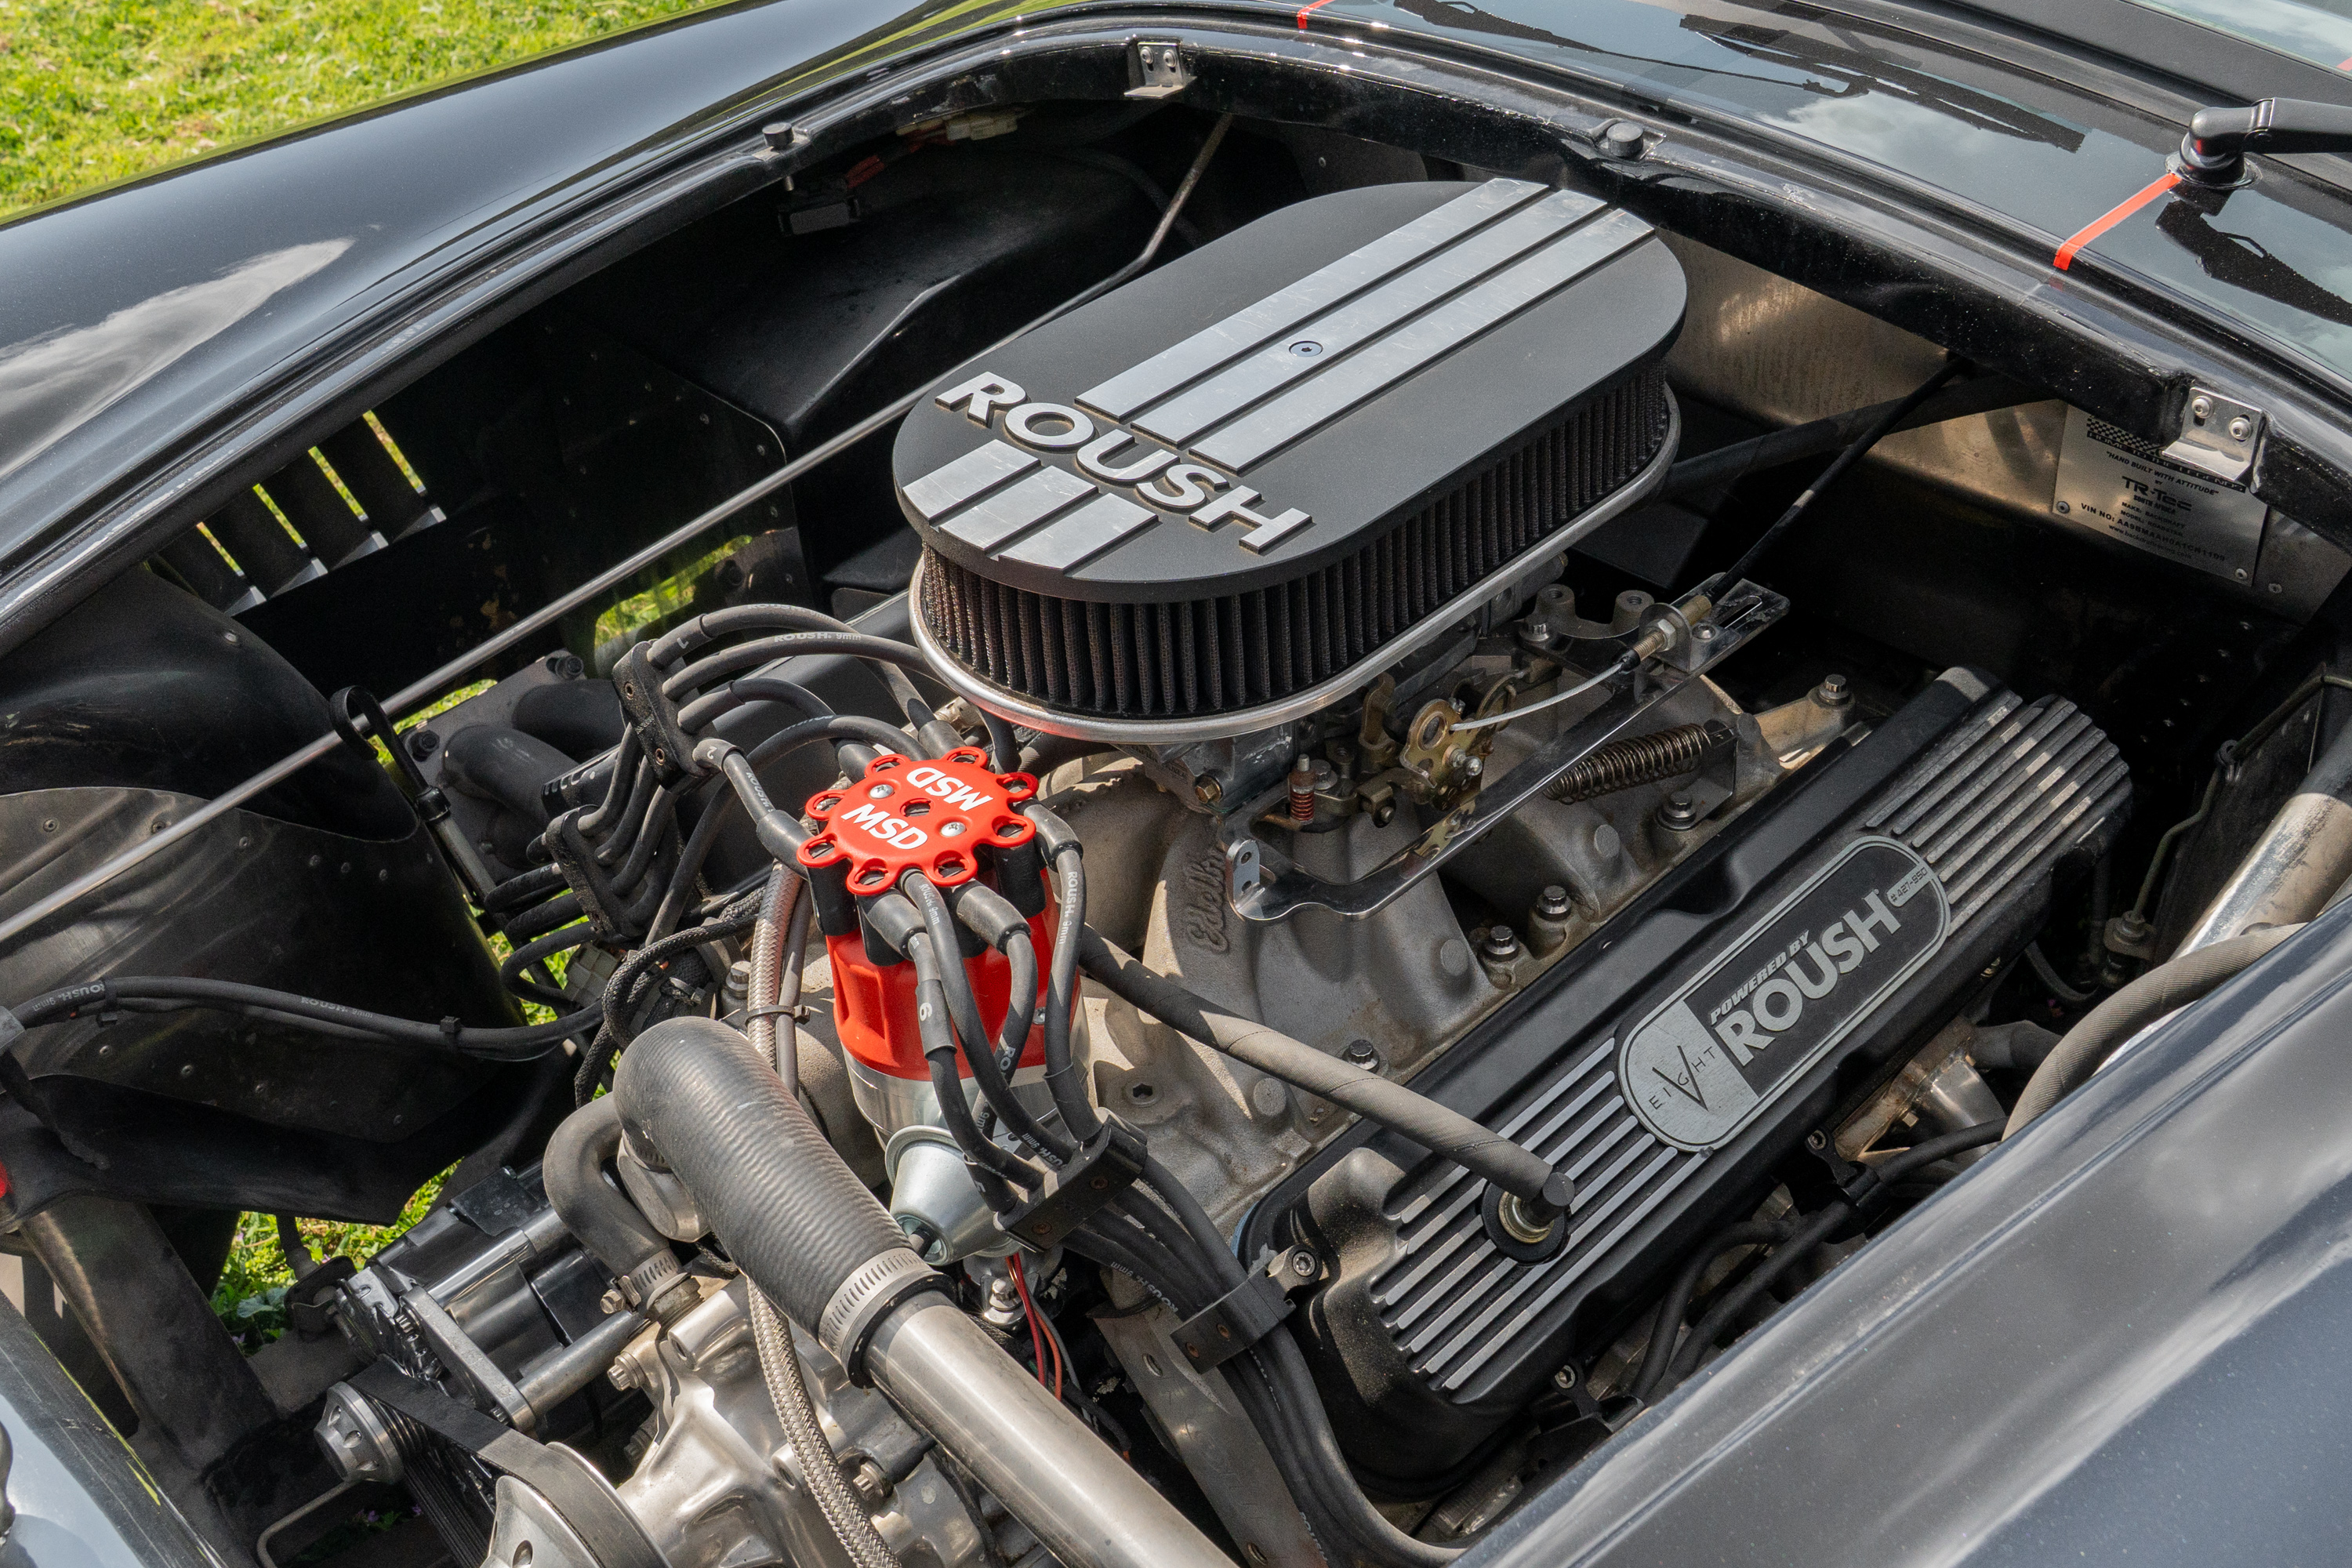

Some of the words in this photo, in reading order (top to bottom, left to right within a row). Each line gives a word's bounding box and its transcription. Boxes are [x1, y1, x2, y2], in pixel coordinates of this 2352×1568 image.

[935, 372, 1312, 554] ROUSH
[2106, 450, 2130, 465] "HAND
[2130, 460, 2153, 474] BUILT
[2154, 469, 2174, 482] WITH
[2175, 475, 2219, 499] ATTITUDE"
[2080, 502, 2096, 514] VIN
[2098, 510, 2115, 522] NO:
[2121, 501, 2142, 514] MAKE:
[836, 632, 862, 641] 9mm
[706, 746, 718, 760] 2
[906, 767, 993, 812] MSD
[840, 803, 928, 850] MSD
[928, 906, 941, 926] 9mm
[909, 934, 920, 950] mm
[1058, 920, 1073, 946] 9mm
[1710, 951, 1788, 1026] POWERED
[1788, 930, 1810, 958] BY
[32, 996, 56, 1012] 9mm
[352, 1008, 373, 1018] 9mm
[976, 1112, 990, 1134] 9m
[1022, 1131, 1040, 1149] 9mm
[1110, 1261, 1134, 1278] 9mm
